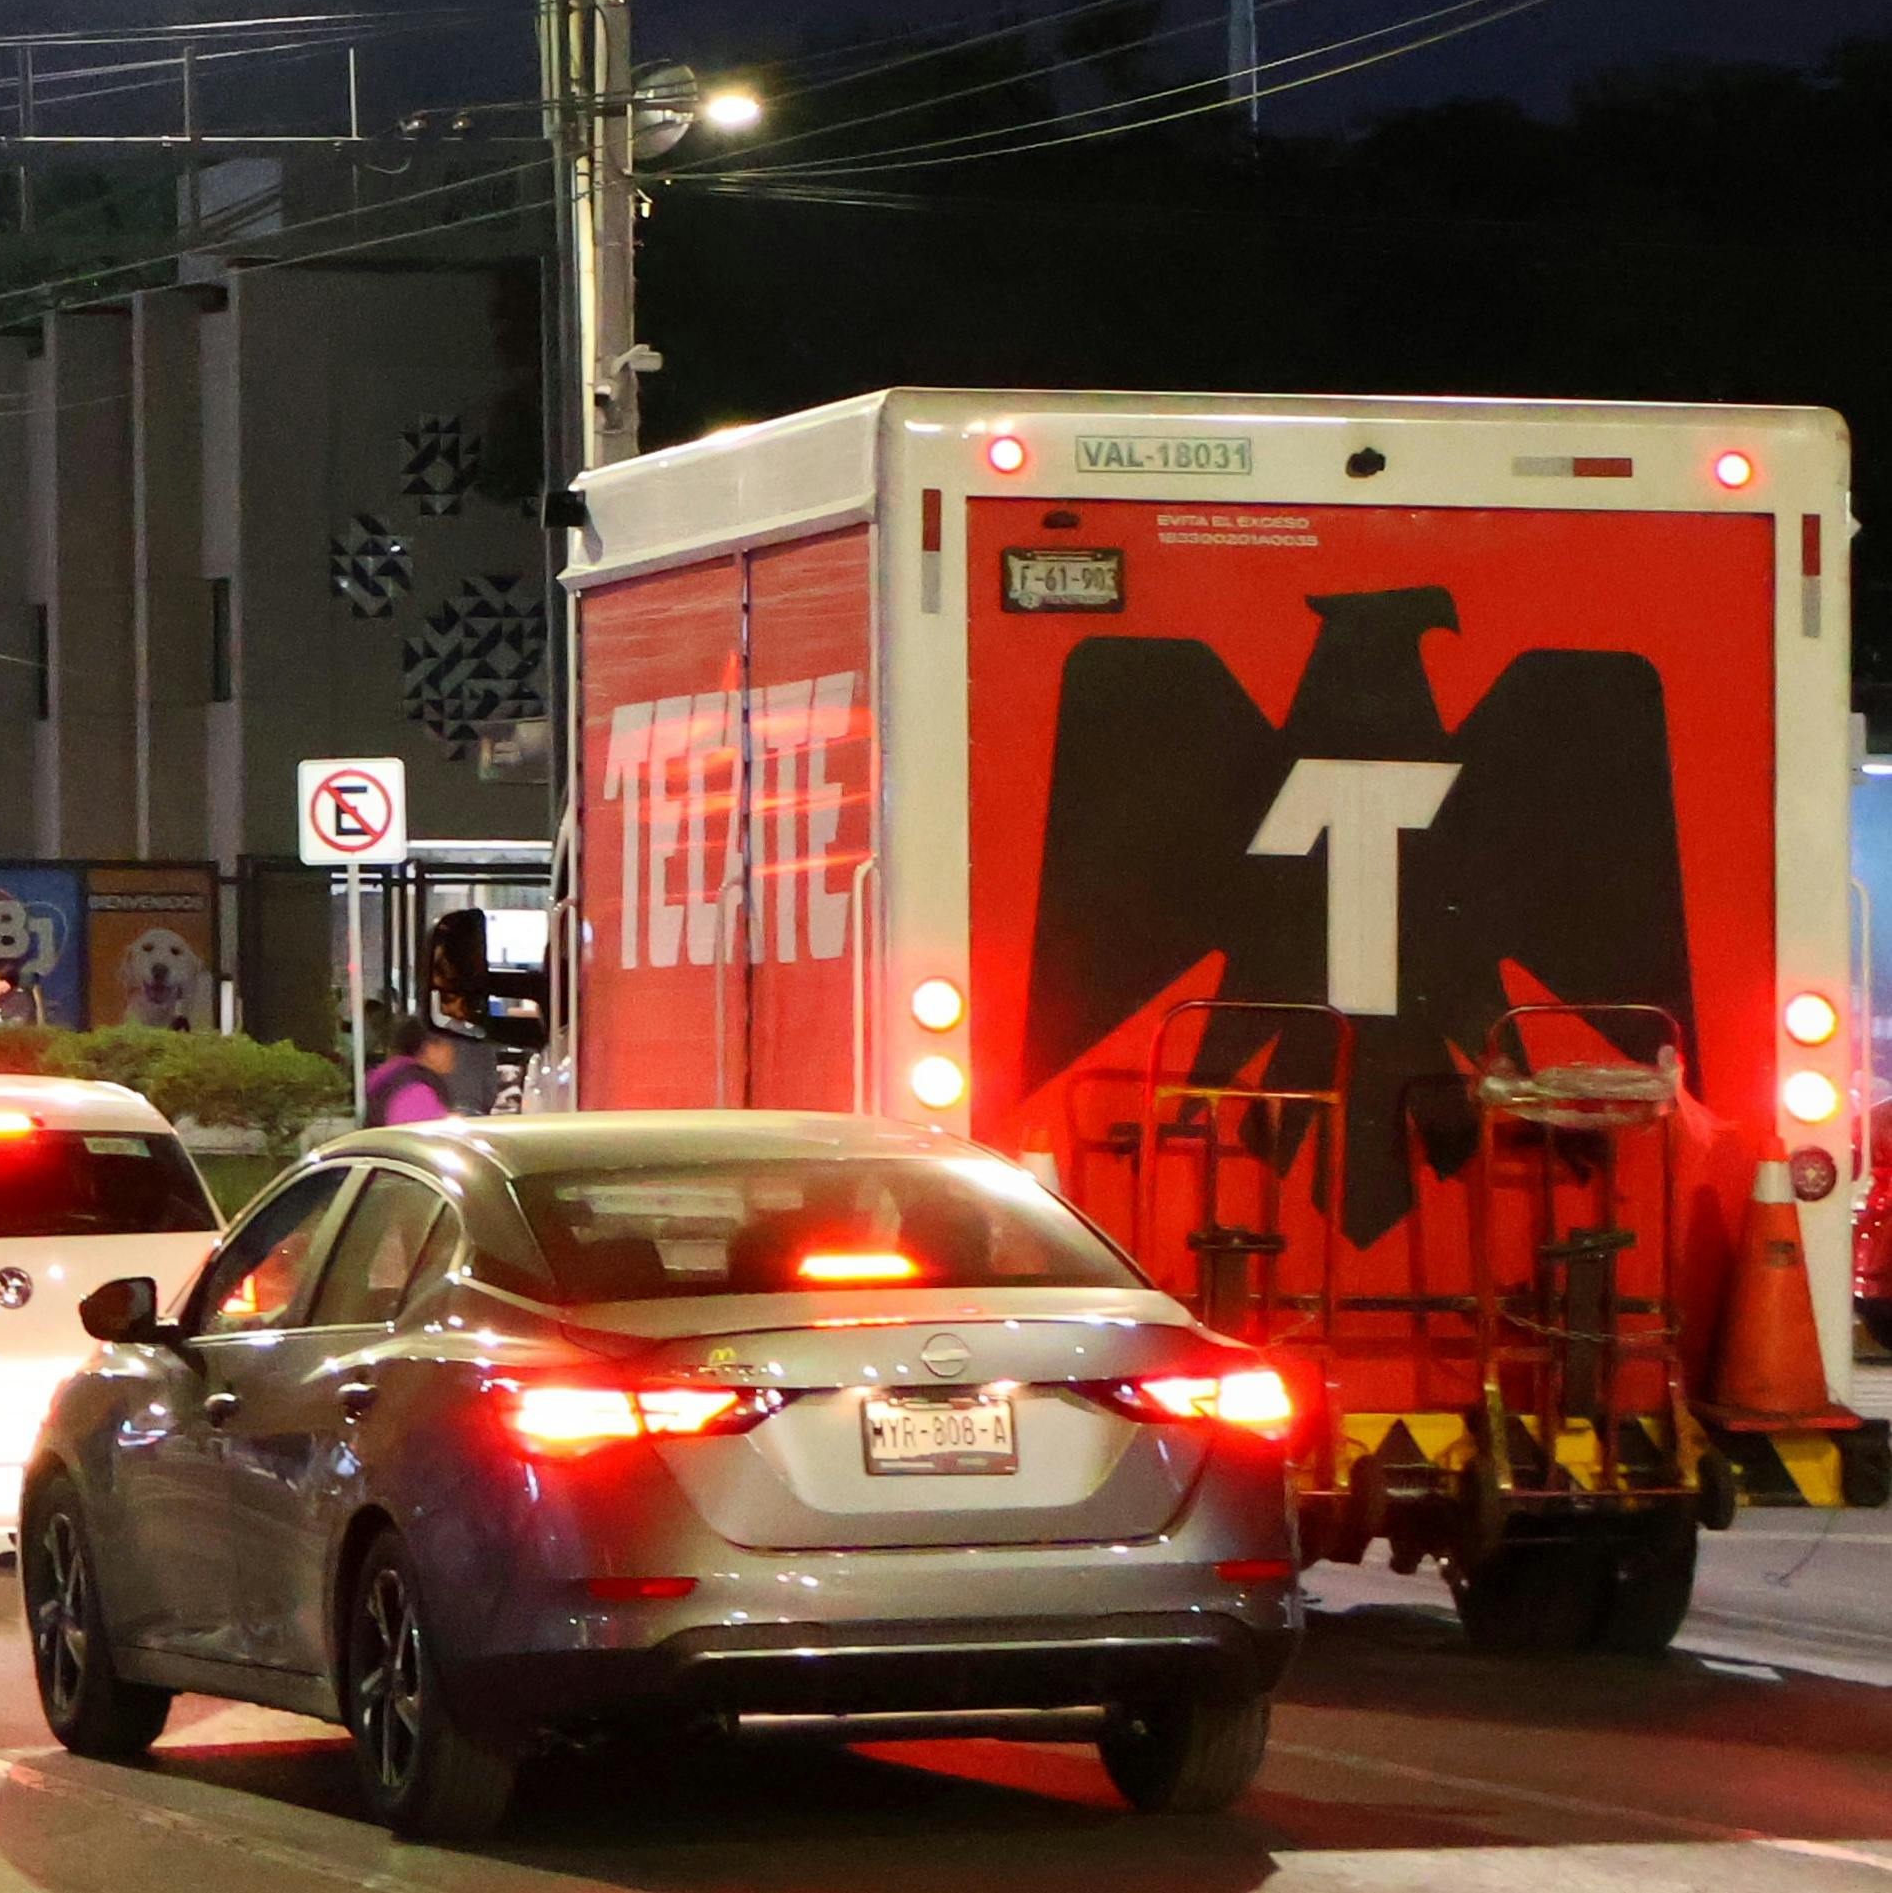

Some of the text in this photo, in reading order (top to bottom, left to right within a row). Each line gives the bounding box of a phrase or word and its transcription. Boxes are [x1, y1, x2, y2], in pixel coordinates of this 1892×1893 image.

[1082, 441, 1246, 469] VAL-18031
[603, 671, 857, 970] TECATE
[1246, 758, 1464, 1016] T
